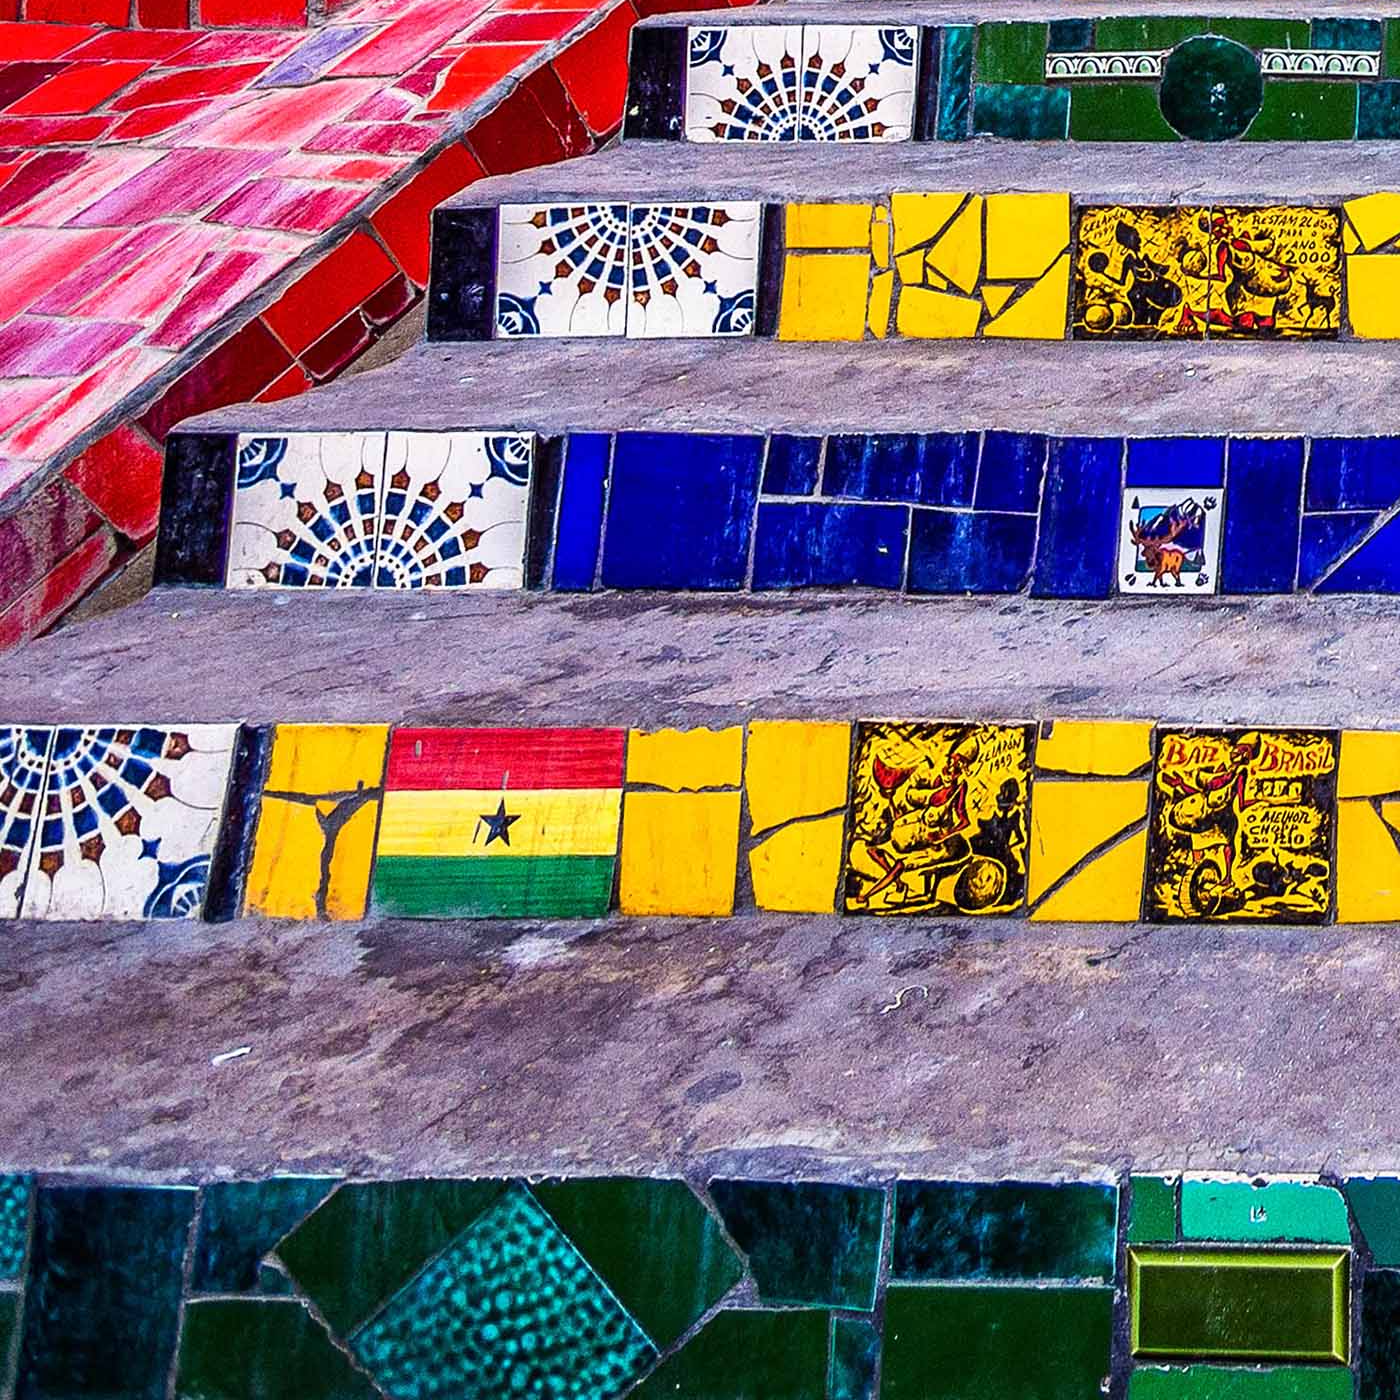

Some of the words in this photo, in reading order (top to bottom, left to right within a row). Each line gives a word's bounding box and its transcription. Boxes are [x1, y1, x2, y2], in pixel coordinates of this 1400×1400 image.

[1291, 240, 1316, 250] ANO
[1285, 249, 1331, 264] 2000
[1164, 738, 1219, 768] BAR
[1261, 811, 1310, 824] MELHOR
[1274, 834, 1304, 844] RIO
